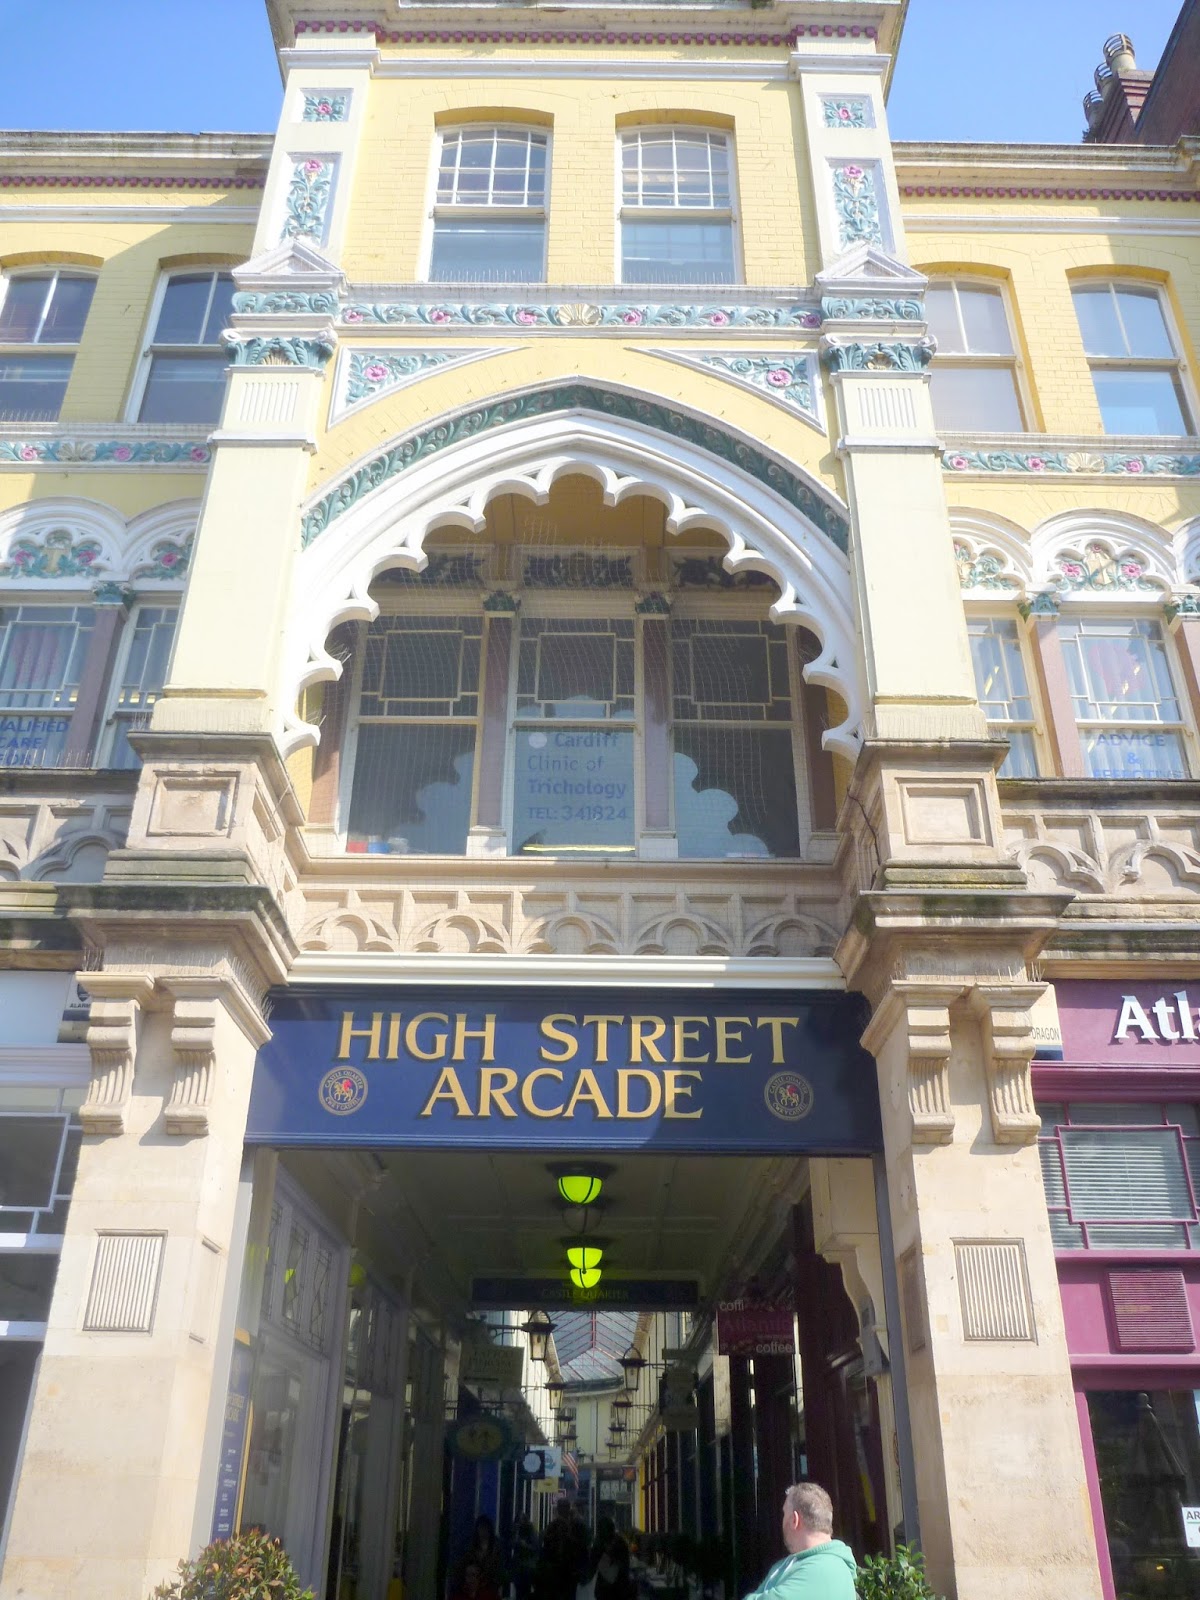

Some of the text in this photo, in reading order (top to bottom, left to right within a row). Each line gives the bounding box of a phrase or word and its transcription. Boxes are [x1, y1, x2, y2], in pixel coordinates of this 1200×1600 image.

[0, 720, 69, 732] ALIFIED
[555, 733, 619, 748] Cardiff
[1096, 734, 1165, 747] ADVICE
[528, 755, 604, 771] Clinic of
[1127, 752, 1141, 765] &
[528, 779, 627, 799] Trichology
[1115, 990, 1200, 1040] Atl
[337, 1011, 800, 1064] HIGH STREET
[421, 1066, 703, 1119] ARCADE
[755, 1341, 793, 1354] coffee
